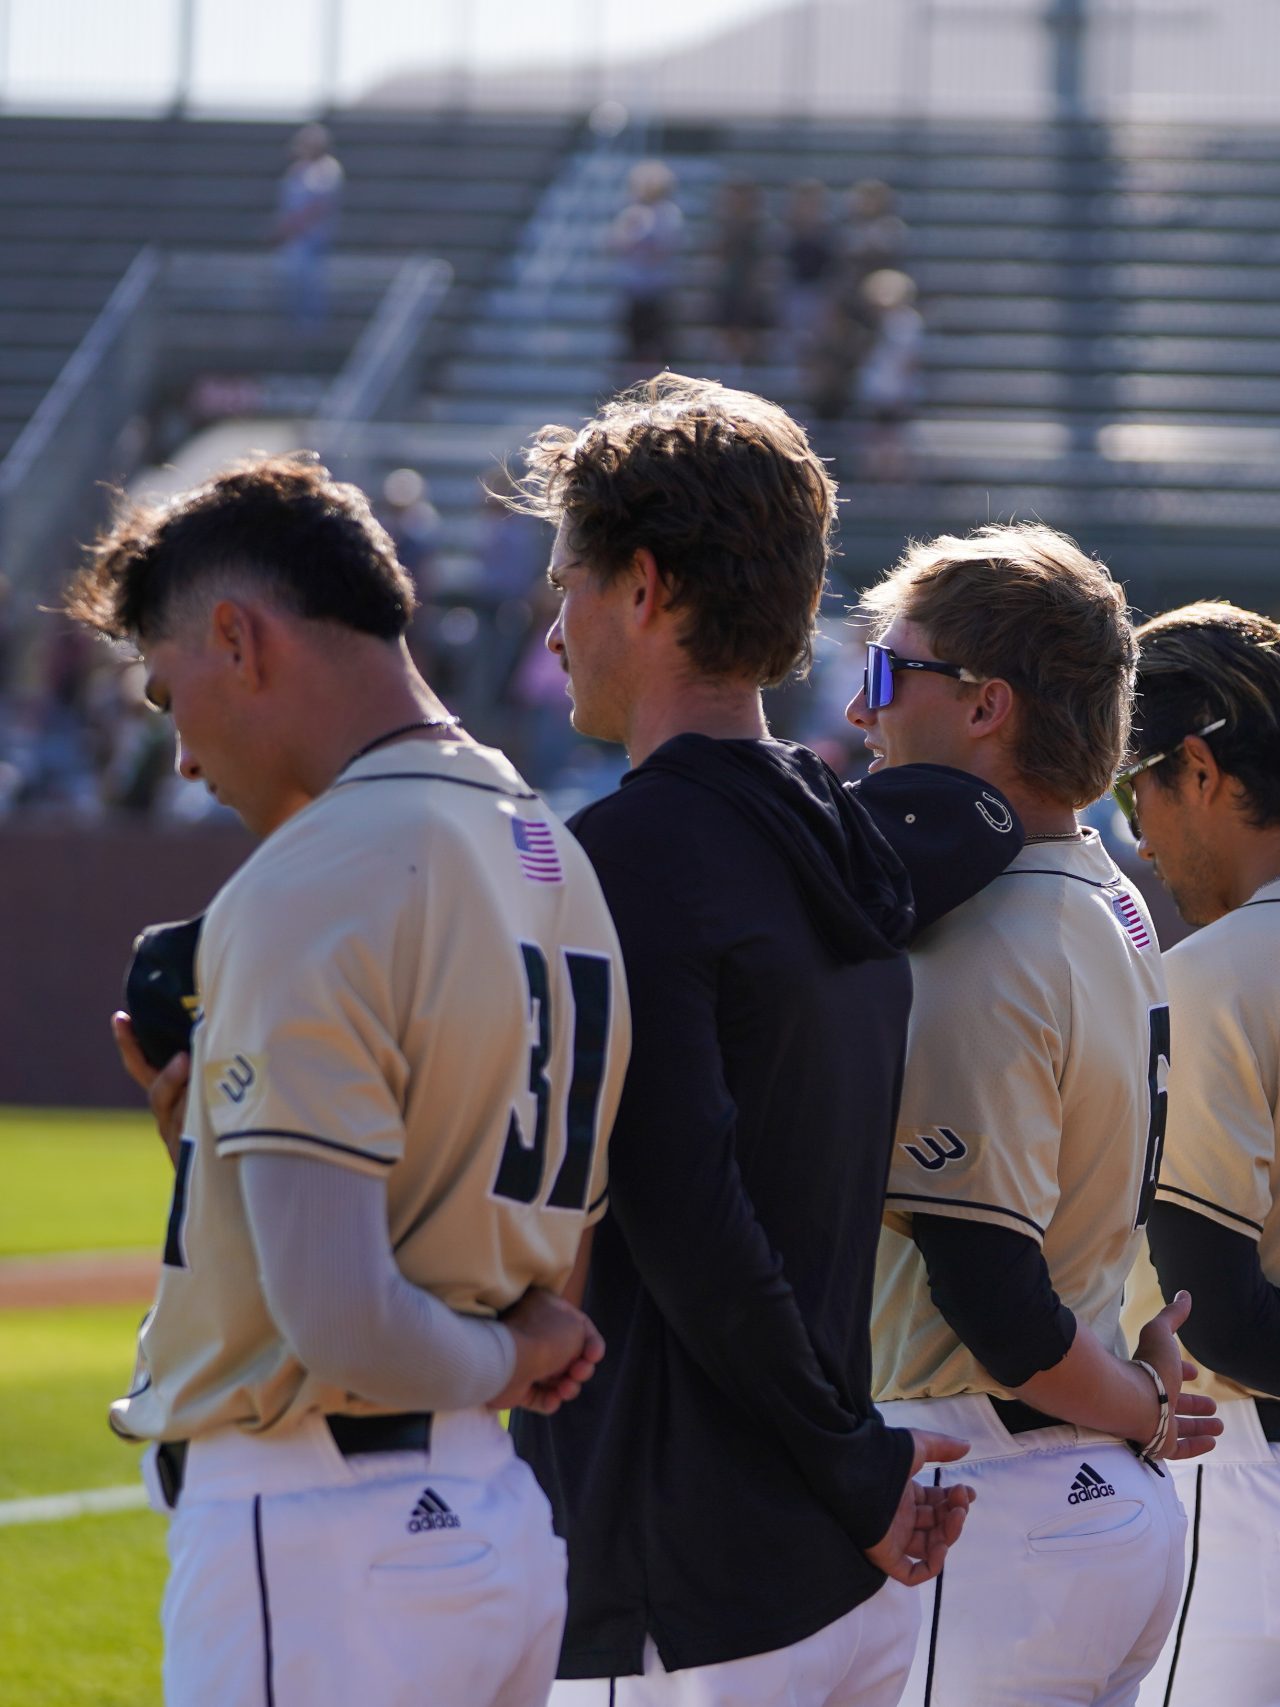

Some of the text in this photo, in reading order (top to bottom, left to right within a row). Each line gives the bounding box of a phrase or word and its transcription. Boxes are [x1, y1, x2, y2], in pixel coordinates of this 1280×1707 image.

[489, 941, 613, 1213] 31
[1068, 1482, 1116, 1505] adidas
[407, 1512, 462, 1534] adidas
